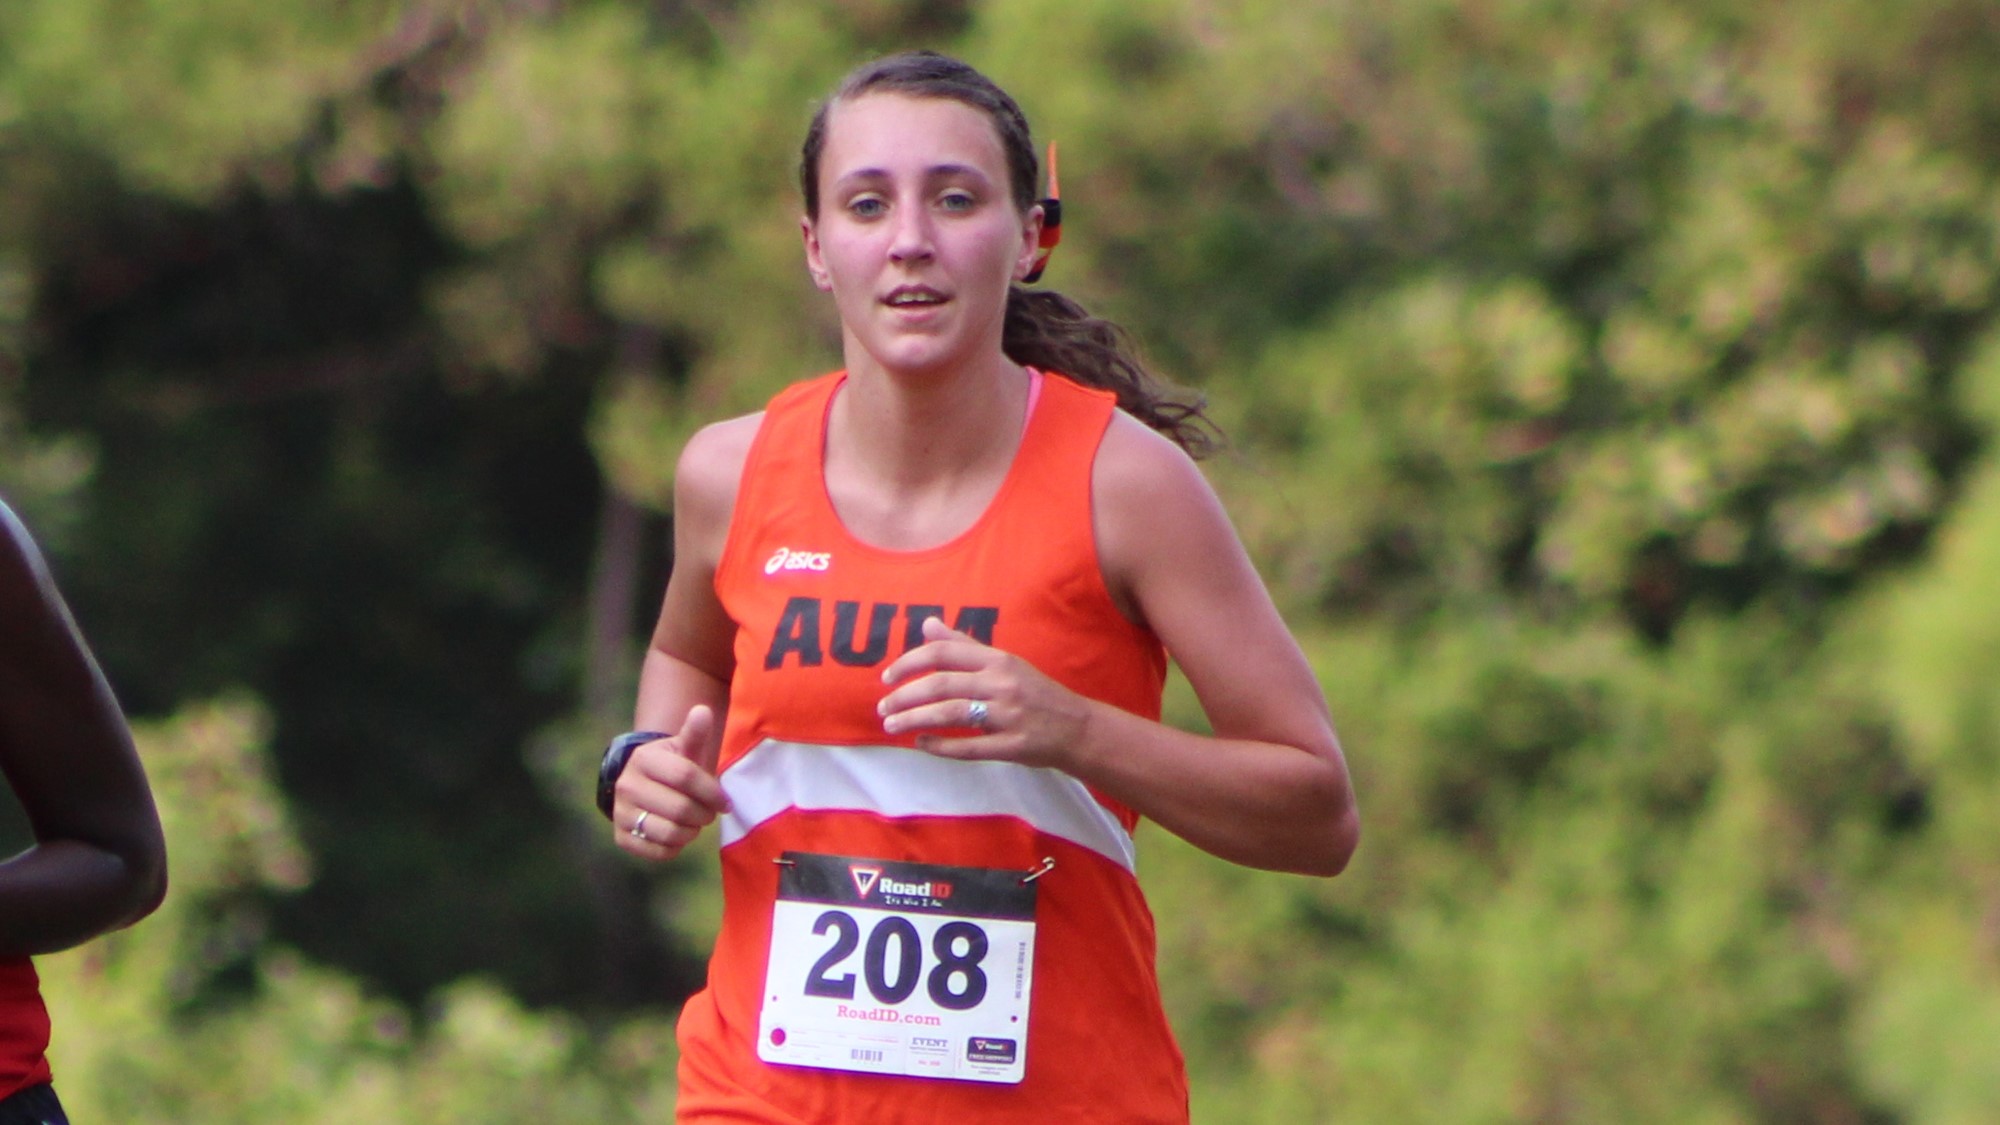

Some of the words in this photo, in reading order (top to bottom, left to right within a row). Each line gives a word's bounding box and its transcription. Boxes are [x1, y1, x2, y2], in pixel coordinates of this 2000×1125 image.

[804, 910, 988, 1010] 208
[837, 1004, 941, 1026] RoadID.com
[911, 1037, 948, 1048] EVENT
